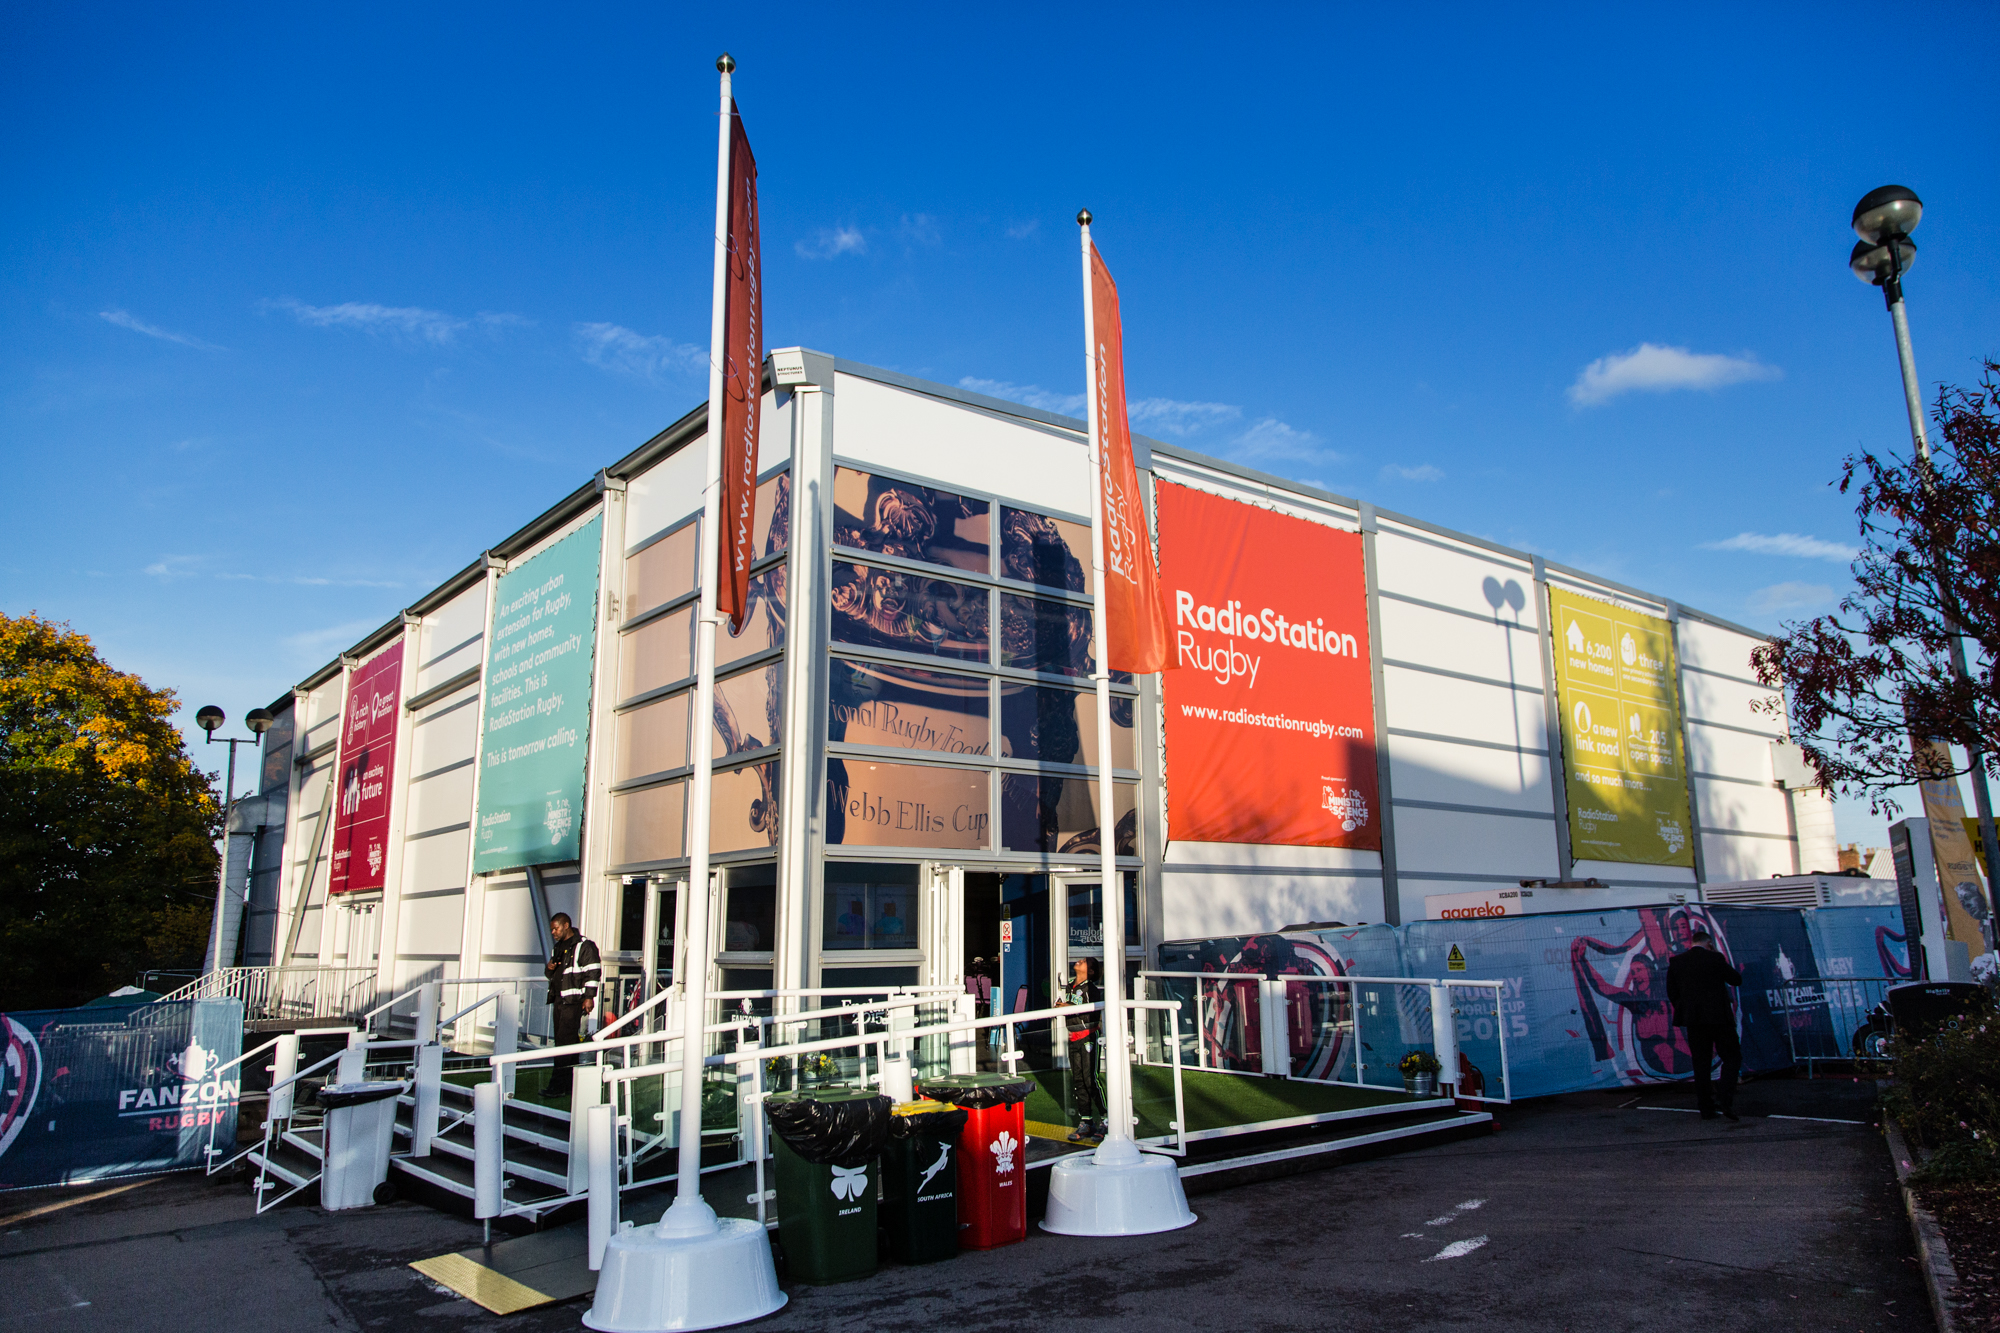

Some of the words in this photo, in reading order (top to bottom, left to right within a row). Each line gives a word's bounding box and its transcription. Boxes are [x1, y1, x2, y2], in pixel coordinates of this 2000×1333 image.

[1099, 343, 1125, 576] RadioStation
[1115, 482, 1137, 585] Rugby
[500, 604, 509, 619] An
[510, 588, 539, 612] exciting
[541, 574, 564, 596] urban
[497, 614, 530, 640] extension
[532, 606, 544, 622] for
[545, 592, 571, 616] Rugby,
[1176, 590, 1358, 658] RadioStation
[494, 643, 510, 662] with
[511, 638, 526, 655] new
[528, 625, 554, 647] homes,
[1586, 641, 1612, 660] 6,200
[492, 662, 517, 686] schools
[519, 653, 534, 673] and
[534, 634, 581, 666] community
[1178, 630, 1260, 688] Rugby
[1570, 658, 1586, 669] new
[1588, 659, 1614, 676] homes
[1638, 653, 1663, 671] three
[491, 684, 523, 708] facilities.
[525, 674, 540, 694] This
[541, 671, 547, 687] is
[359, 702, 369, 719] rich
[377, 704, 392, 718] location
[489, 703, 535, 732] RadioStation
[536, 692, 564, 716] Rugby.
[354, 719, 367, 732] history
[881, 701, 944, 750] Rugby
[1181, 704, 1363, 739] www.radiostationrugby.com
[1593, 724, 1598, 734] a
[1600, 725, 1618, 738] new
[487, 750, 500, 768] This
[501, 747, 507, 763] is
[508, 738, 546, 760] tomorrow
[547, 726, 578, 747] calling.
[1576, 734, 1595, 752] link
[1597, 741, 1619, 756] road
[1649, 730, 1666, 745] 205
[1630, 750, 1649, 763] open
[1650, 754, 1672, 766] space
[1575, 771, 1590, 782] and
[1592, 774, 1600, 784] so
[1602, 775, 1623, 787] much
[362, 782, 382, 801] future
[827, 779, 890, 826] Webb
[895, 800, 944, 832] Ellis
[952, 804, 988, 840] Cup
[1578, 807, 1618, 822] RadioStation
[1441, 901, 1505, 919] aggreko
[149, 1110, 226, 1131] RUGBY
[935, 1192, 953, 1200] AFRICA
[838, 1206, 862, 1216] IRELAND
